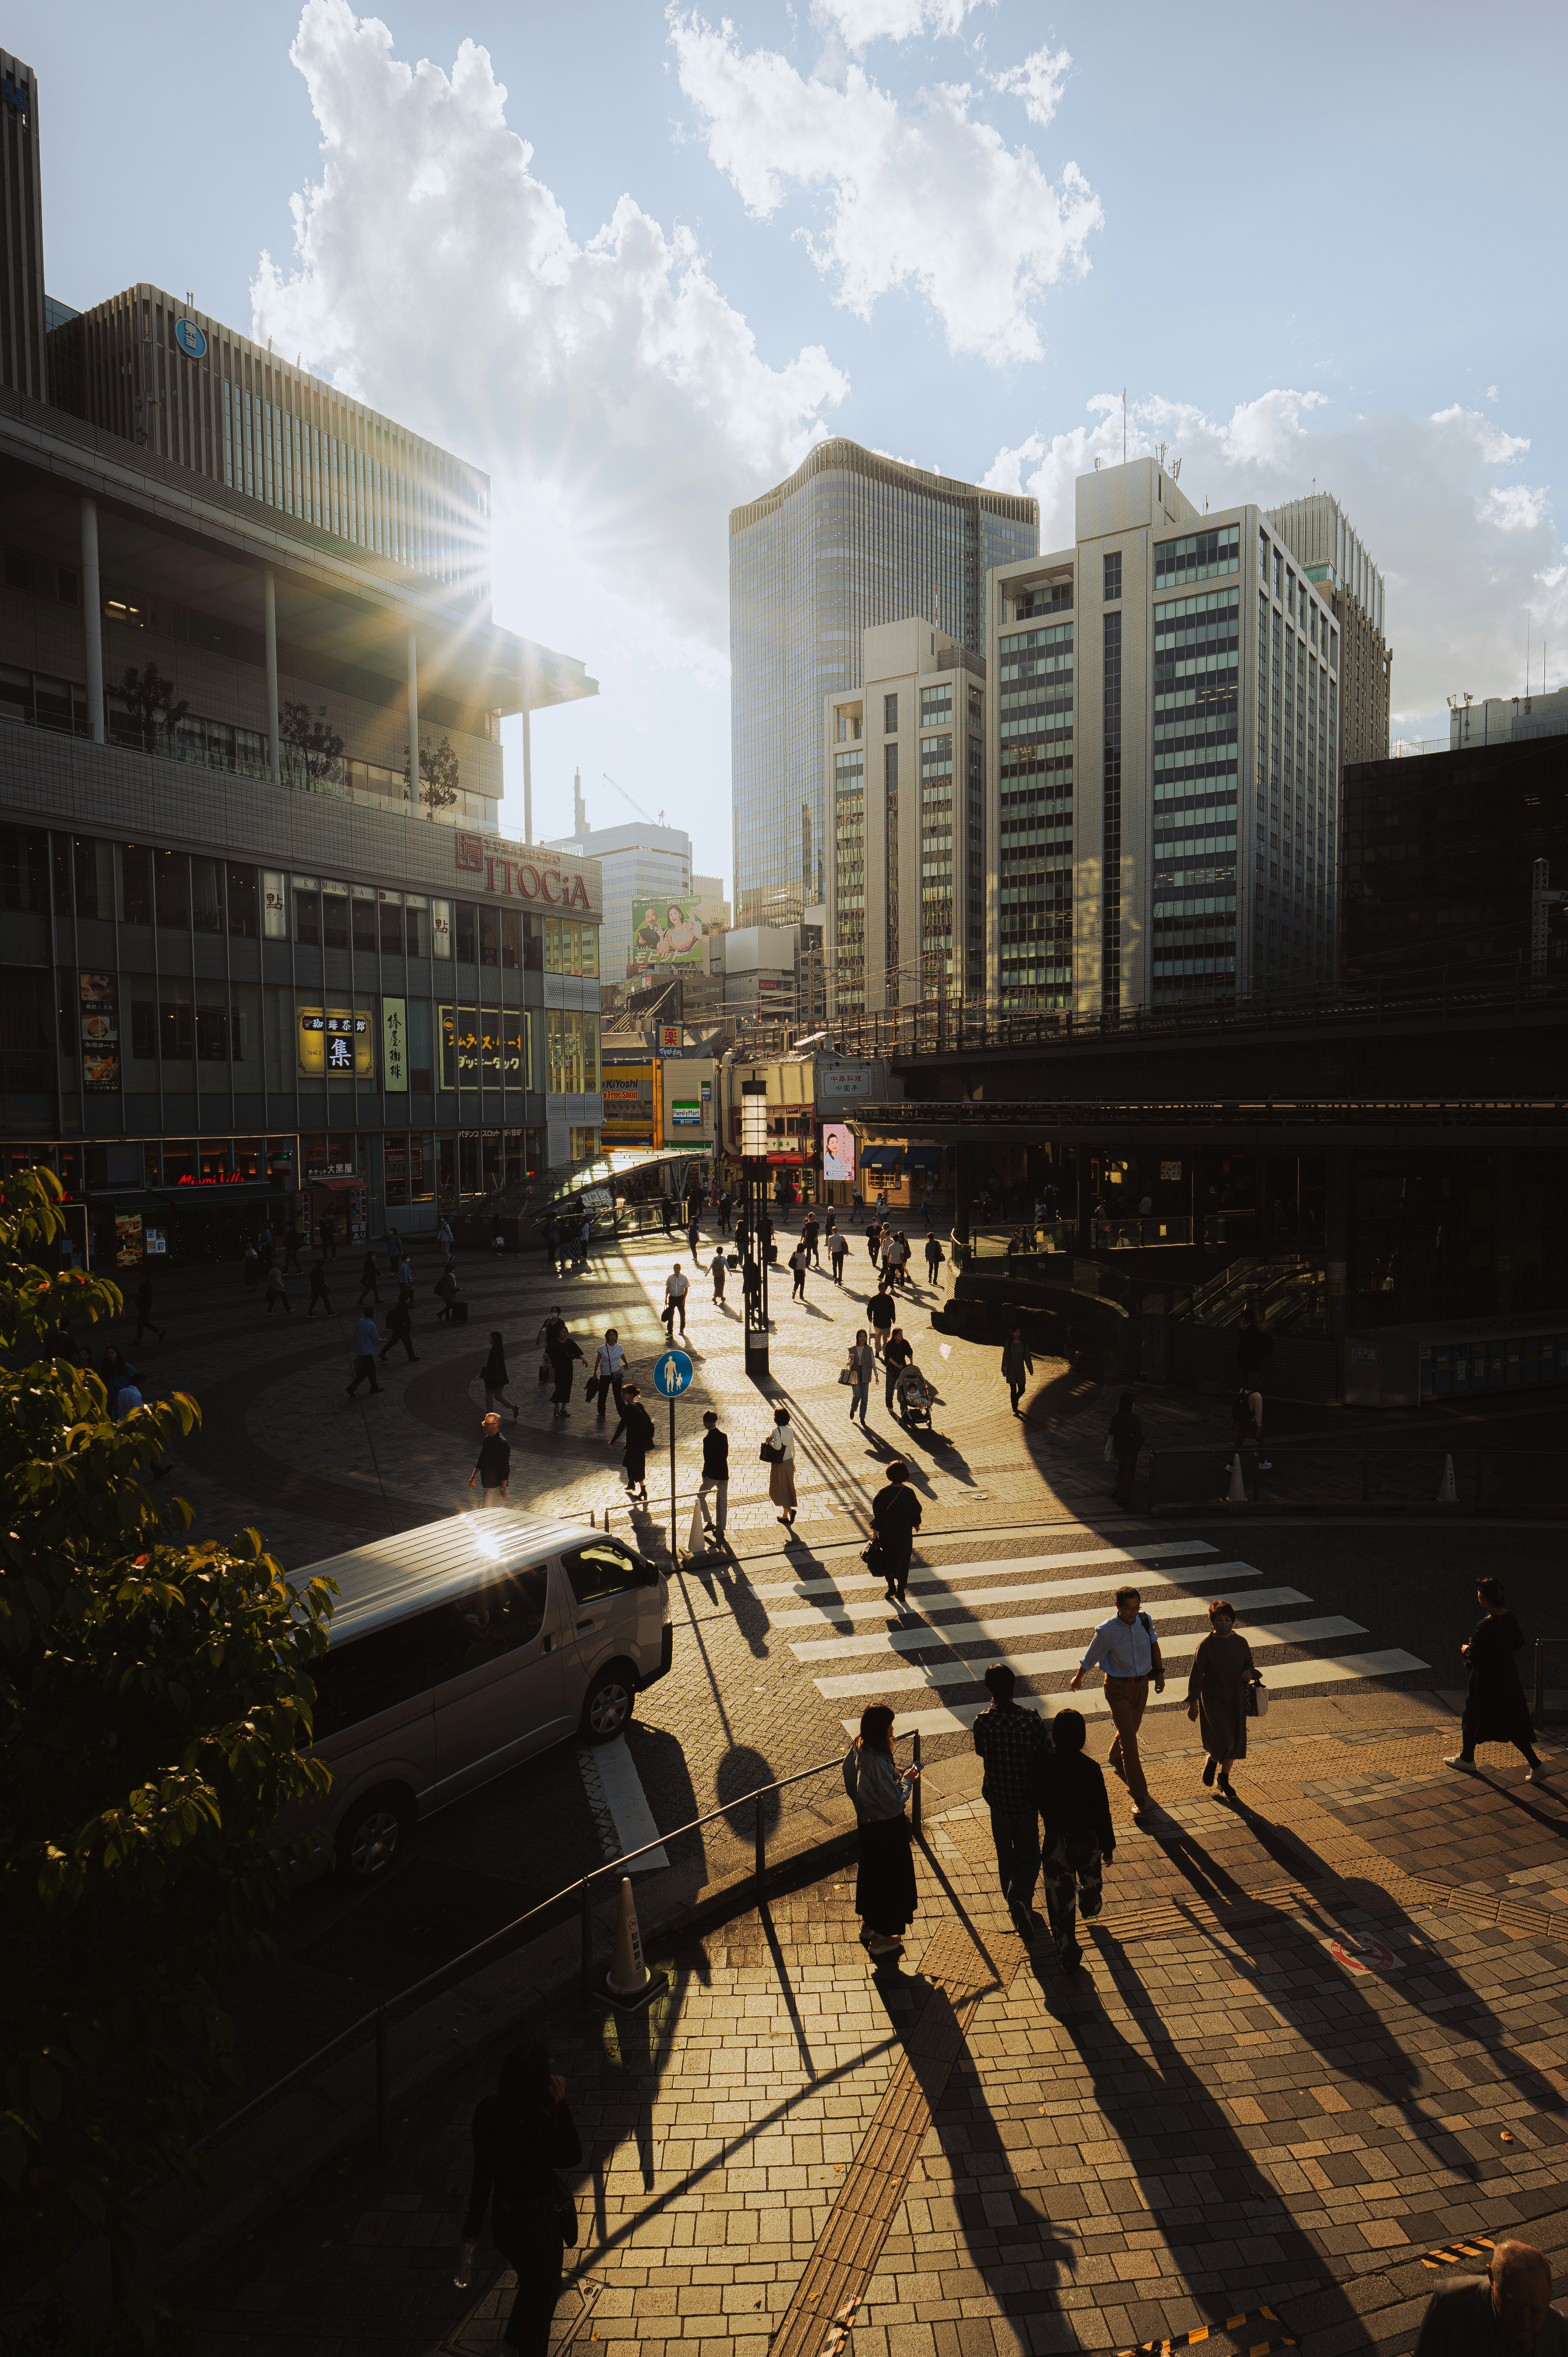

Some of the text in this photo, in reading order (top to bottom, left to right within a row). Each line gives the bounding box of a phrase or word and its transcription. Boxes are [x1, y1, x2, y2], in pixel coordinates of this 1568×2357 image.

[486, 838, 560, 864] YURAKUCHO
[486, 856, 592, 908] ITOCiA
[304, 879, 417, 905] KAMONKA TEN
[313, 1018, 366, 1032] 珈琲茶館
[664, 1027, 678, 1046] 薬
[329, 1039, 351, 1066] 集
[387, 1012, 402, 1080] 椿屋珈琲
[606, 1079, 638, 1088] KiYoshi
[831, 1075, 862, 1083] 中華料理
[608, 1090, 621, 1099] Free
[622, 1090, 638, 1100] Shop
[178, 1171, 245, 1185] Miami Villa
[352, 1224, 367, 1232] 個室
[631, 1931, 642, 1970] 駐輪禁止
[1359, 1959, 1393, 1970] 千代田区
